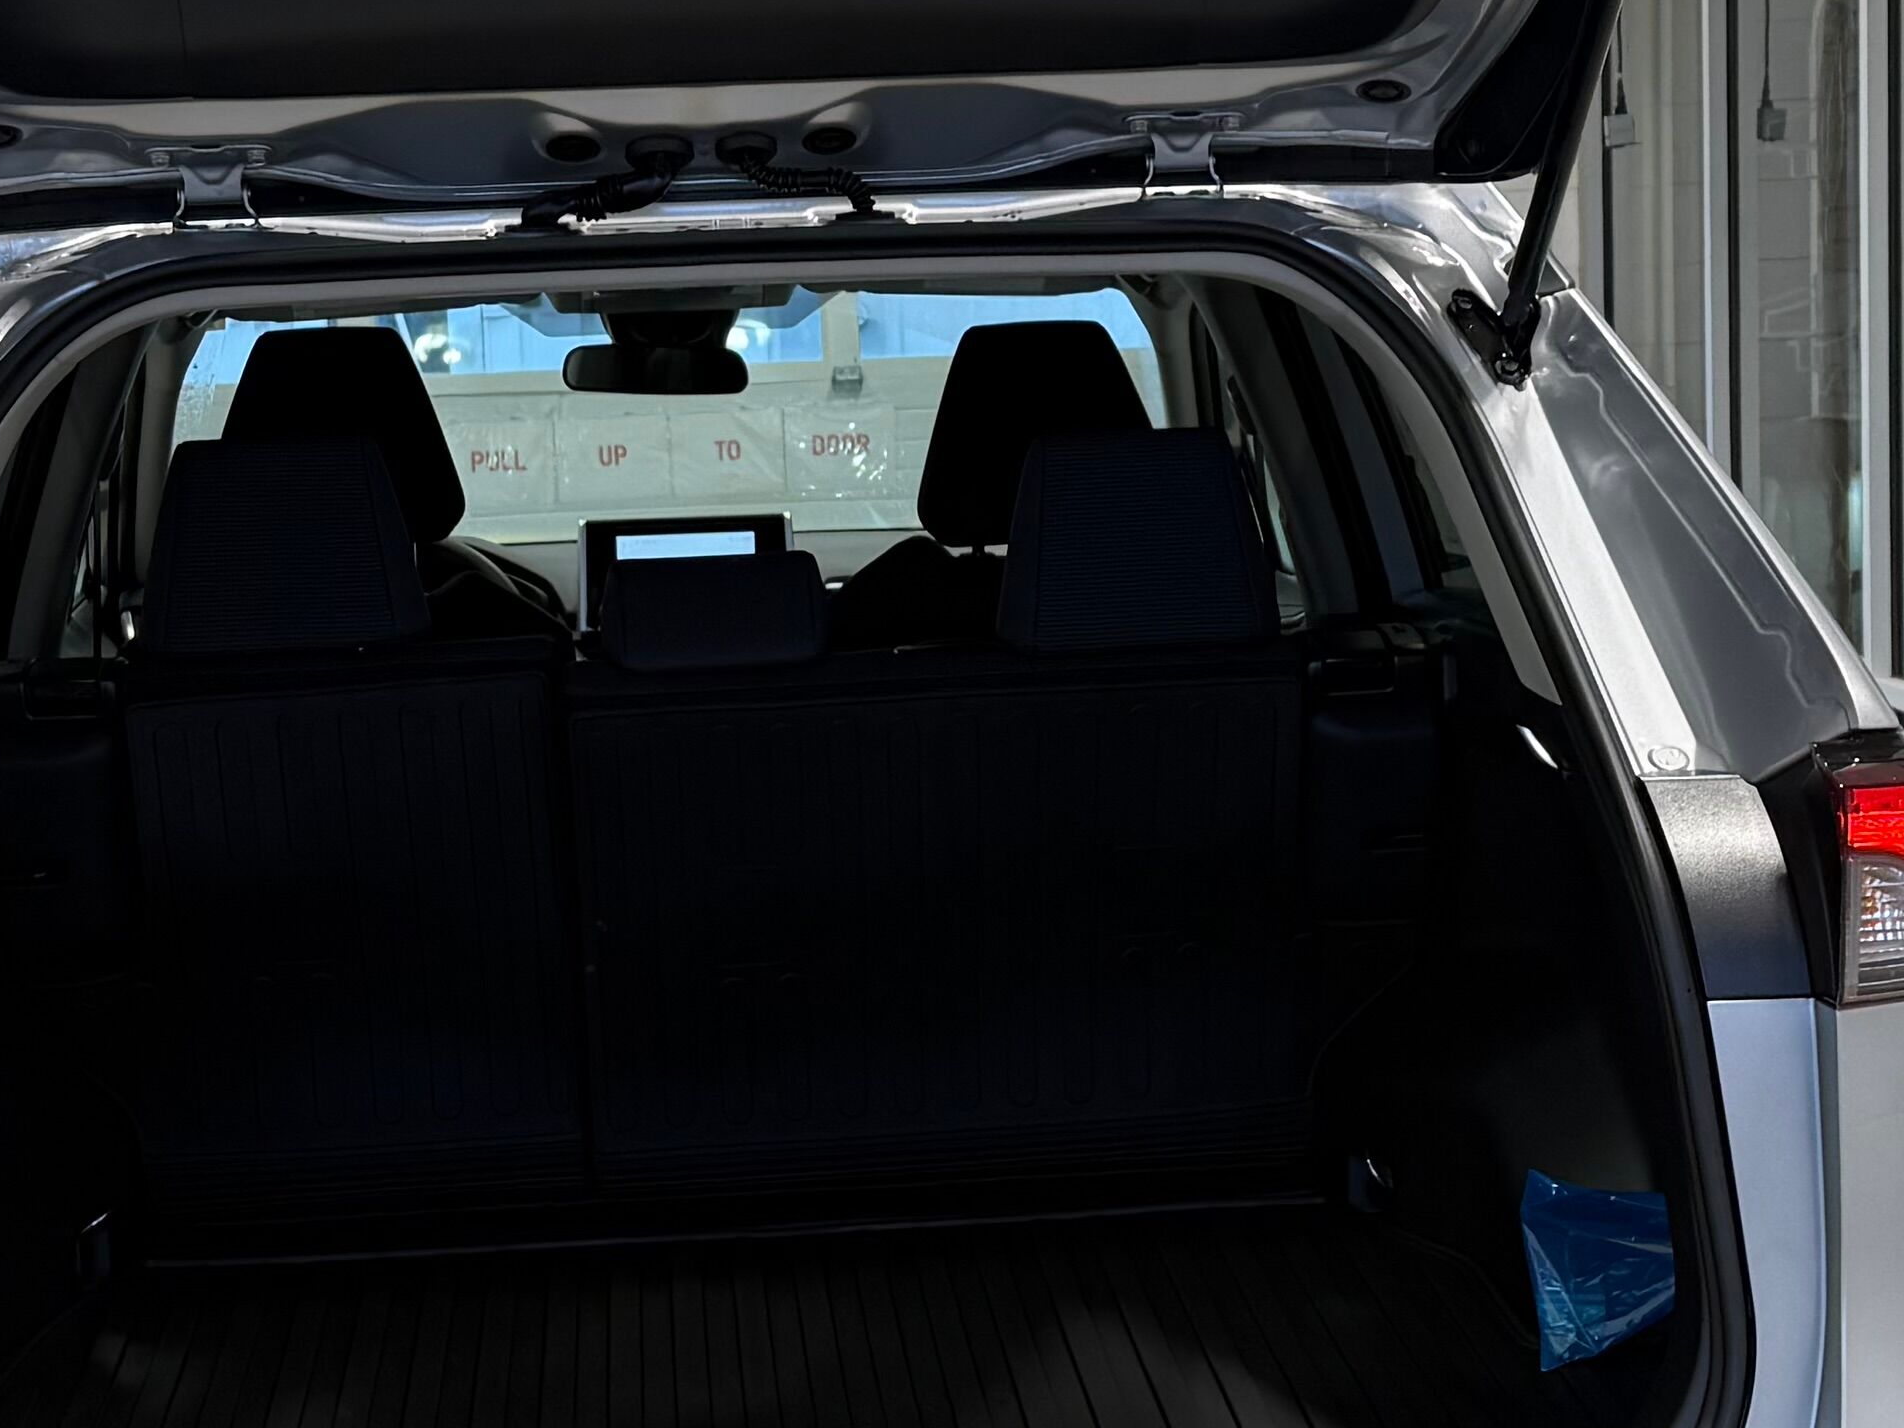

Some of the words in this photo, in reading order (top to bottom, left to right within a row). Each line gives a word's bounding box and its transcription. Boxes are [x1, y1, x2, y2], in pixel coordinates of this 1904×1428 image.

[470, 450, 527, 473] PULL
[599, 445, 627, 466] UP
[714, 440, 741, 461] TO
[812, 434, 870, 456] DOOR
